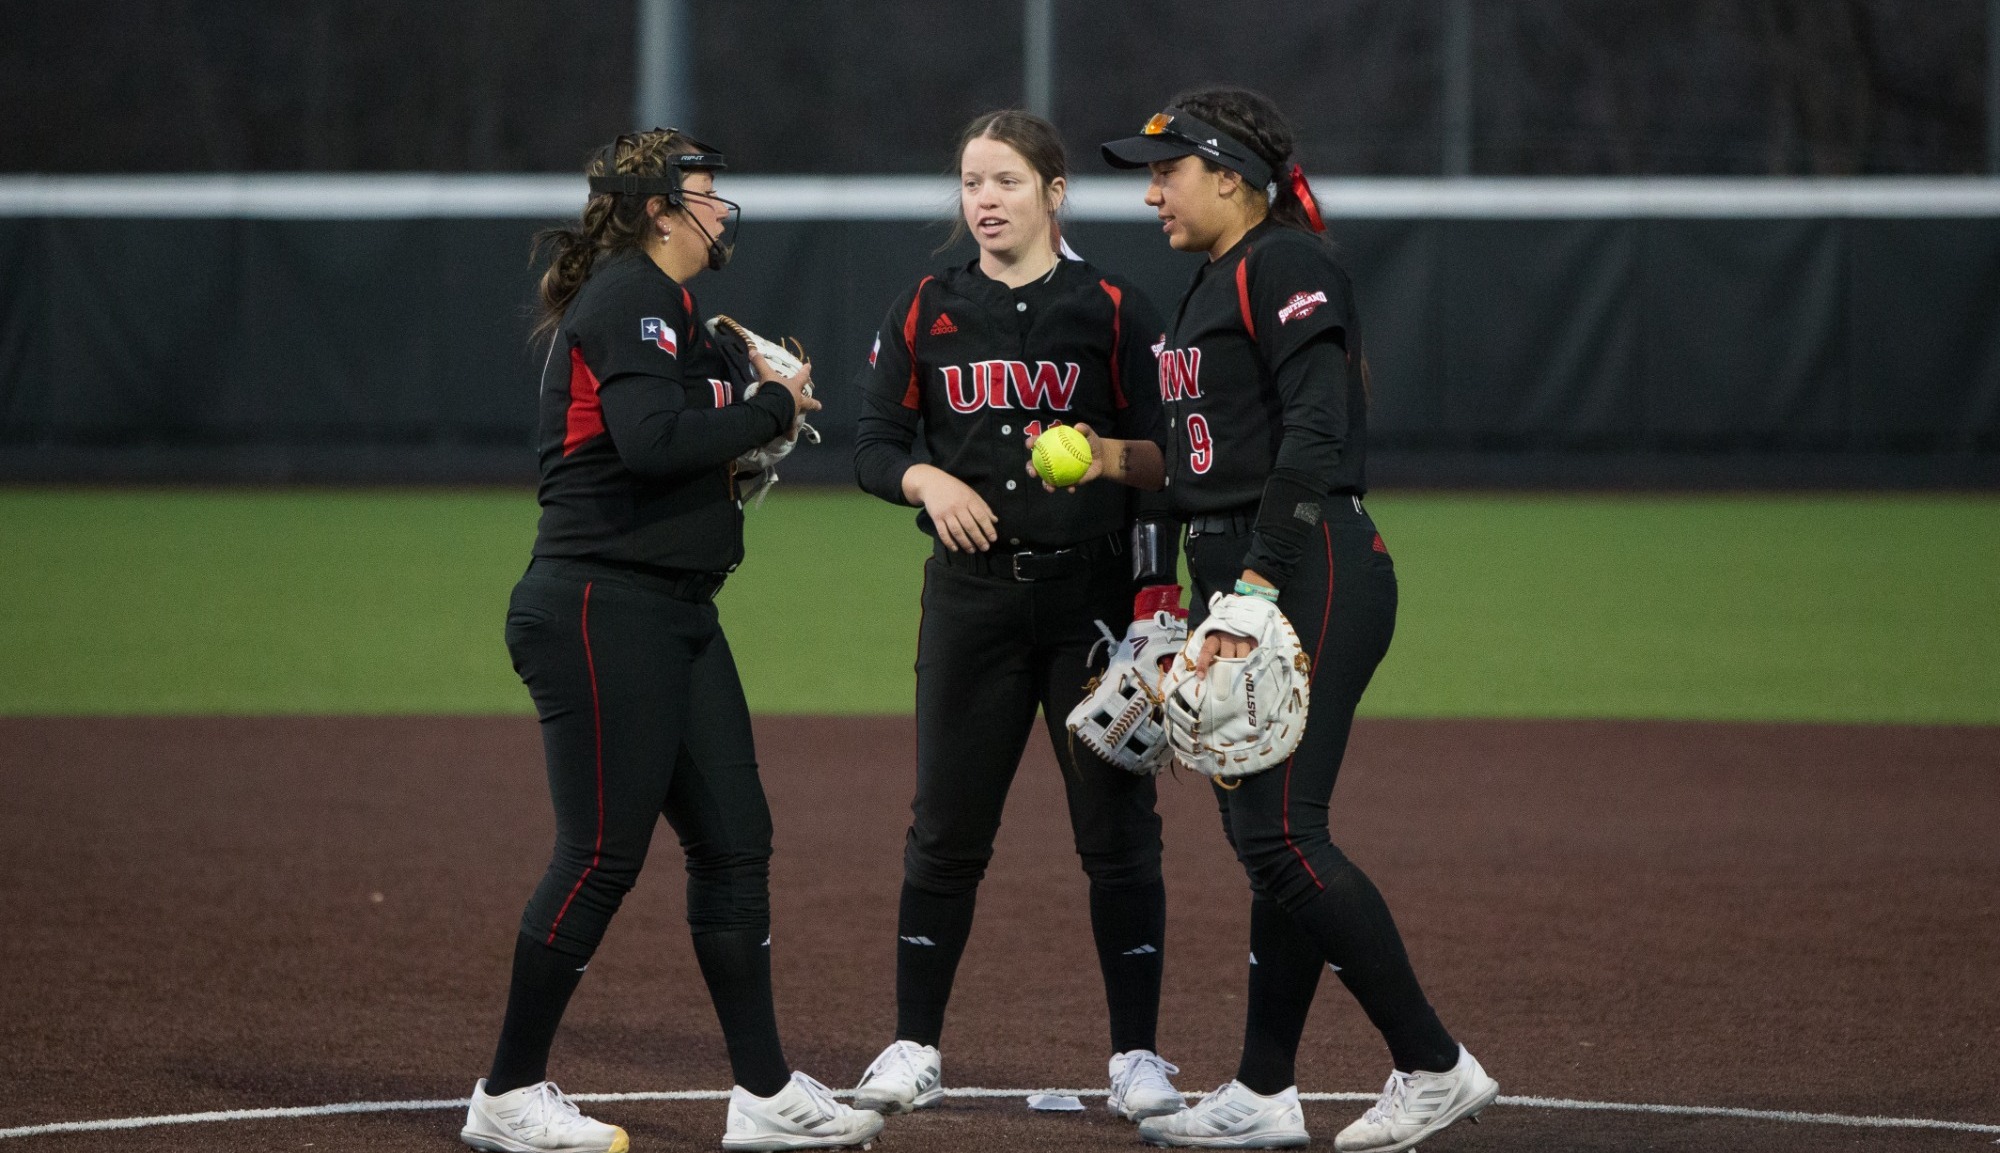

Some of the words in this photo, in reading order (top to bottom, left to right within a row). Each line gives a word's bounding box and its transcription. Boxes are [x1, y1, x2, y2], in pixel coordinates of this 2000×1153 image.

[930, 325, 959, 336] adidas
[1278, 291, 1328, 325] SOUTHLAND
[939, 359, 1081, 414] UIW
[1159, 347, 1202, 402] IW
[1187, 413, 1213, 474] 9
[1244, 672, 1257, 728] EASTON
